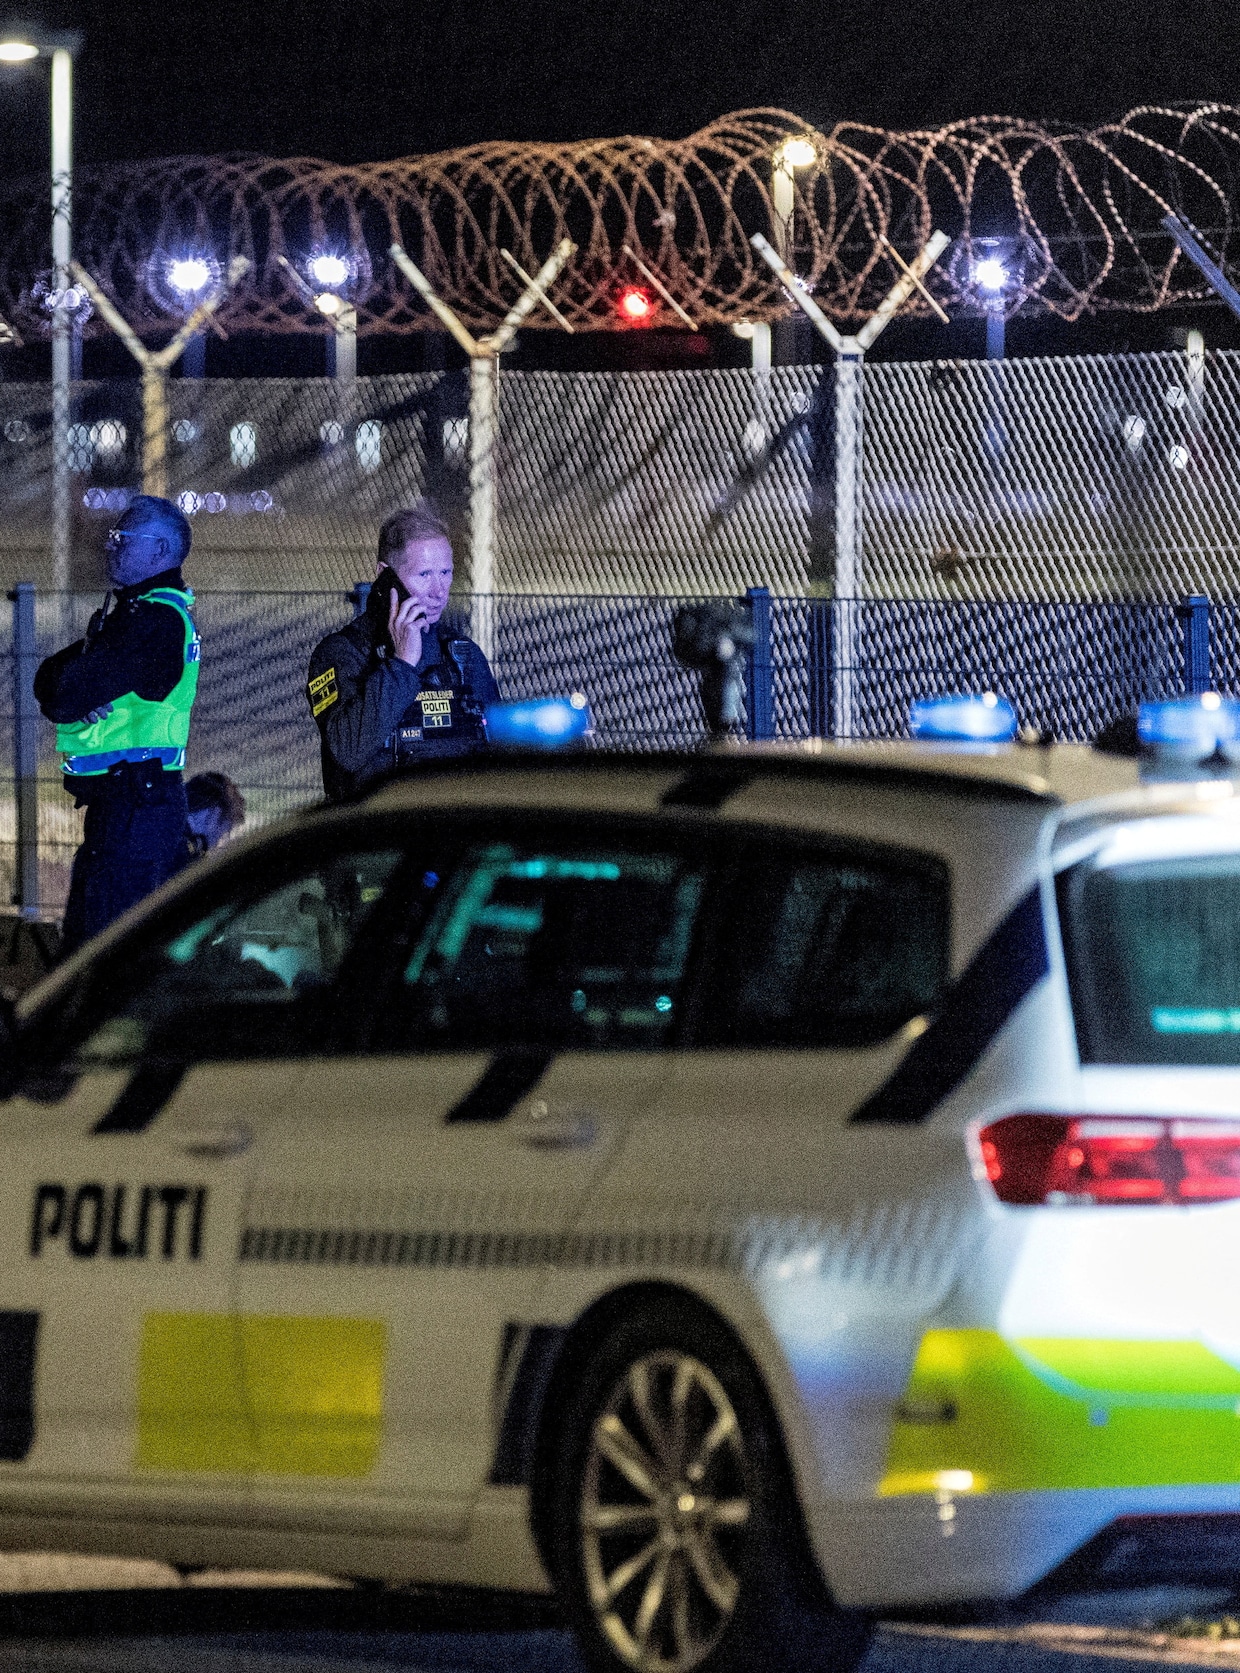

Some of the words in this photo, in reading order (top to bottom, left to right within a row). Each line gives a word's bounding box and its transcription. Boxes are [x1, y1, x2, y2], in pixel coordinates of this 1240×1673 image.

[311, 671, 333, 691] POLITI
[319, 686, 330, 698] 11
[424, 702, 449, 713] POLITI
[431, 715, 443, 727] 11
[29, 1182, 208, 1259] POLITI
